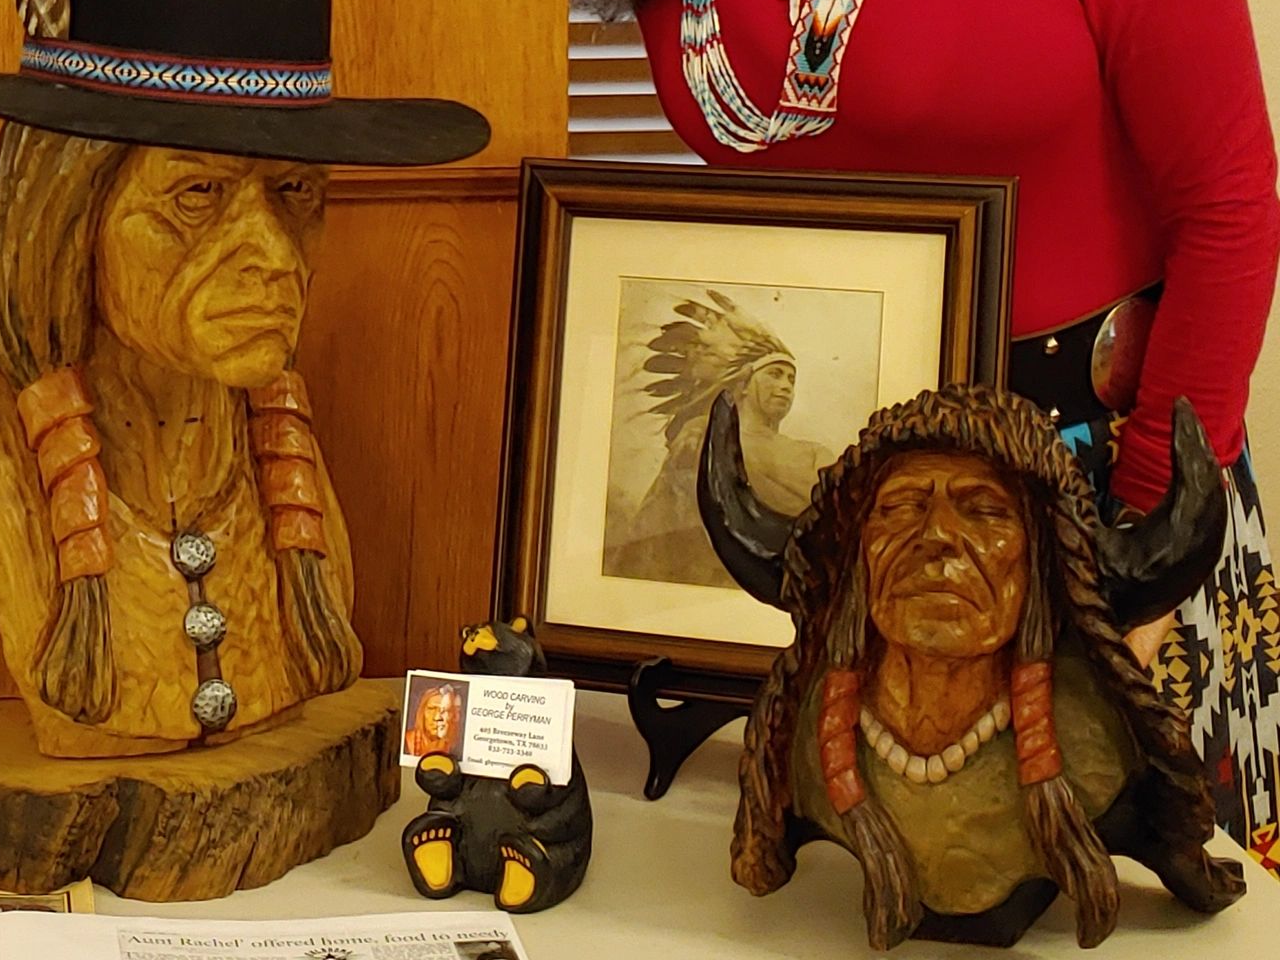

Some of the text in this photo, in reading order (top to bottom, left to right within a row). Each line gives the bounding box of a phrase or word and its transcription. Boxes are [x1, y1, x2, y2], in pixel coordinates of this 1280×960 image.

[483, 689, 546, 705] WOOD CARVING
[505, 702, 515, 713] by
[471, 707, 552, 725] GEORGE PERRYMAN
[528, 731, 544, 740] Lane
[517, 739, 527, 748] TX
[250, 937, 315, 948] offered
[384, 932, 426, 943] food
[457, 929, 509, 940] needy
